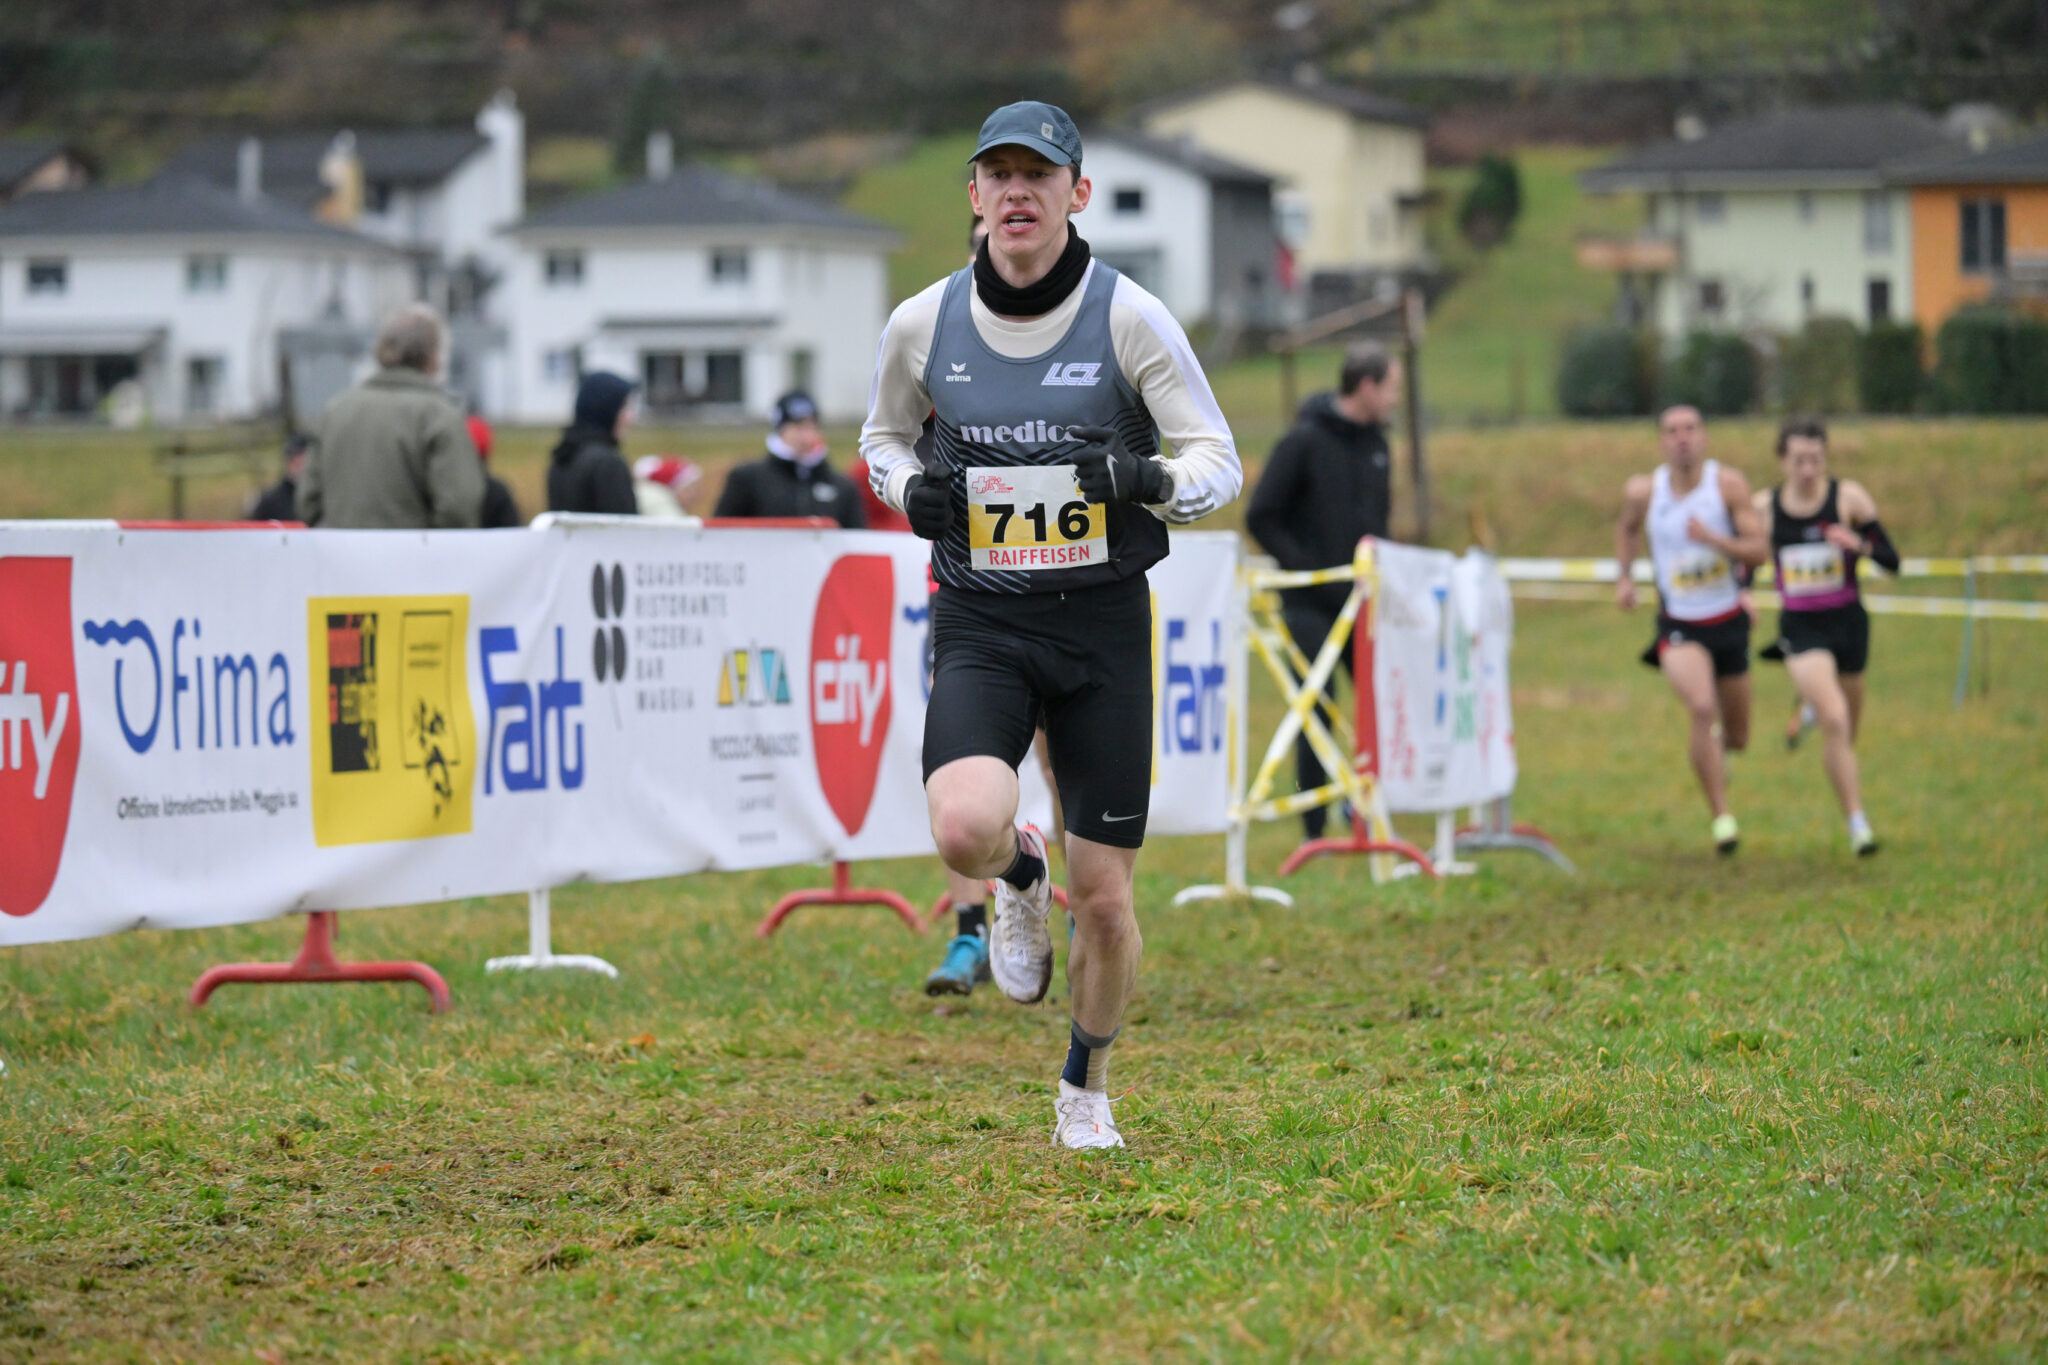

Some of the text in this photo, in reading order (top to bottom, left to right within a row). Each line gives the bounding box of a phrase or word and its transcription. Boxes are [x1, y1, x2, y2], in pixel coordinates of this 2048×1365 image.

[945, 374, 972, 383] erima
[1041, 362, 1102, 386] LCZ
[985, 500, 1091, 544] 716
[988, 544, 1091, 566] RAIFFEISEN
[82, 617, 295, 755] Ofima
[479, 625, 585, 796] Fart
[814, 633, 887, 748] city
[0, 660, 70, 800] ty
